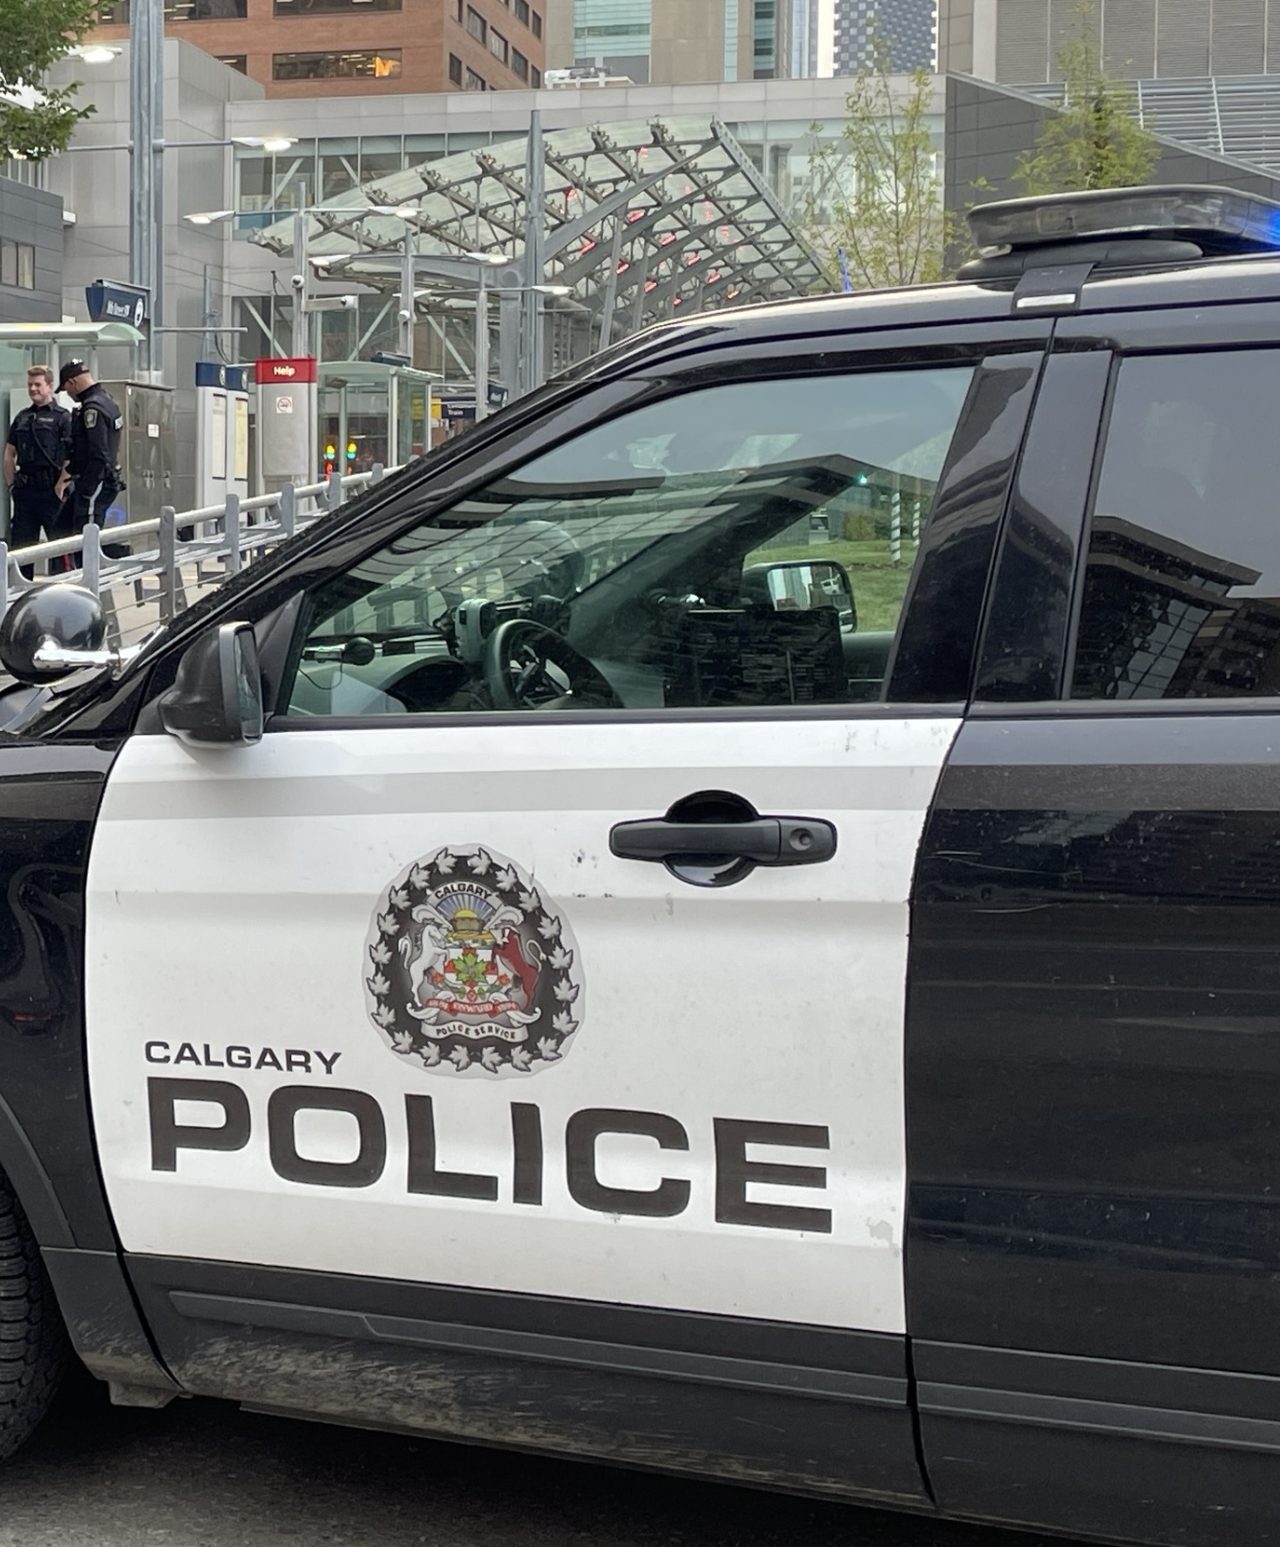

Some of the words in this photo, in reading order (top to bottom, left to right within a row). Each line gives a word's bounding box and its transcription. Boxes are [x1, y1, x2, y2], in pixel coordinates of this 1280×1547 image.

[273, 366, 295, 377] Help
[434, 882, 492, 900] CALGARY
[436, 1023, 470, 1036] POLICE
[474, 1024, 516, 1039] SERVICE
[145, 1041, 342, 1075] CALGARY
[147, 1076, 832, 1233] POLICE
